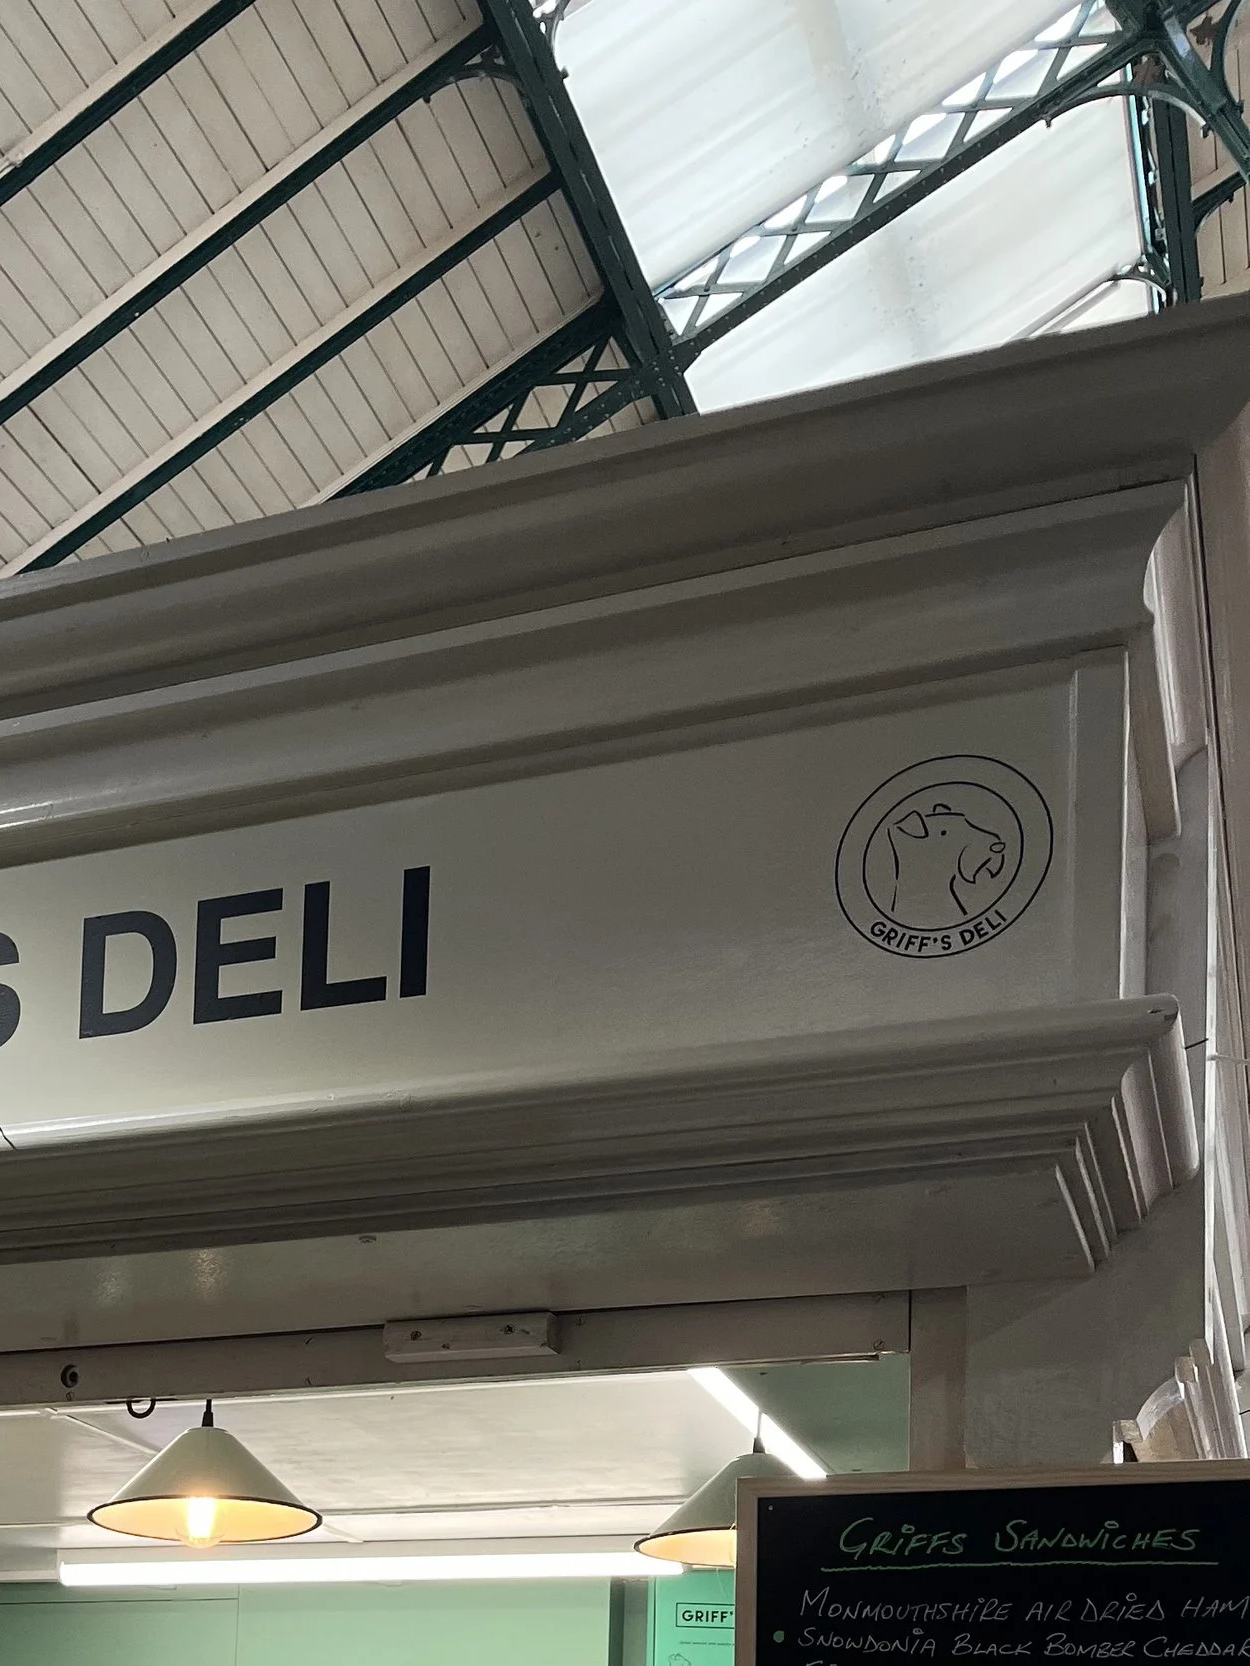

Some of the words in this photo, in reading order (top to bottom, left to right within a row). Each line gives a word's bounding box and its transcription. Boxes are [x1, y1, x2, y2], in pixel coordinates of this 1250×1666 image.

[870, 921, 952, 952] GRIFF'S
[959, 909, 1007, 946] DELI
[78, 865, 432, 1040] DELI
[839, 1517, 967, 1559] GRIFFS
[995, 1520, 1200, 1551] SANDWICHES
[682, 1610, 733, 1623] GRIFF'
[1025, 1601, 1070, 1621] AIR
[1181, 1595, 1249, 1619] HAM
[951, 1635, 1033, 1656] BLACK
[1044, 1632, 1136, 1658] BOMBER
[1143, 1636, 1250, 1658] CHEDDAR
